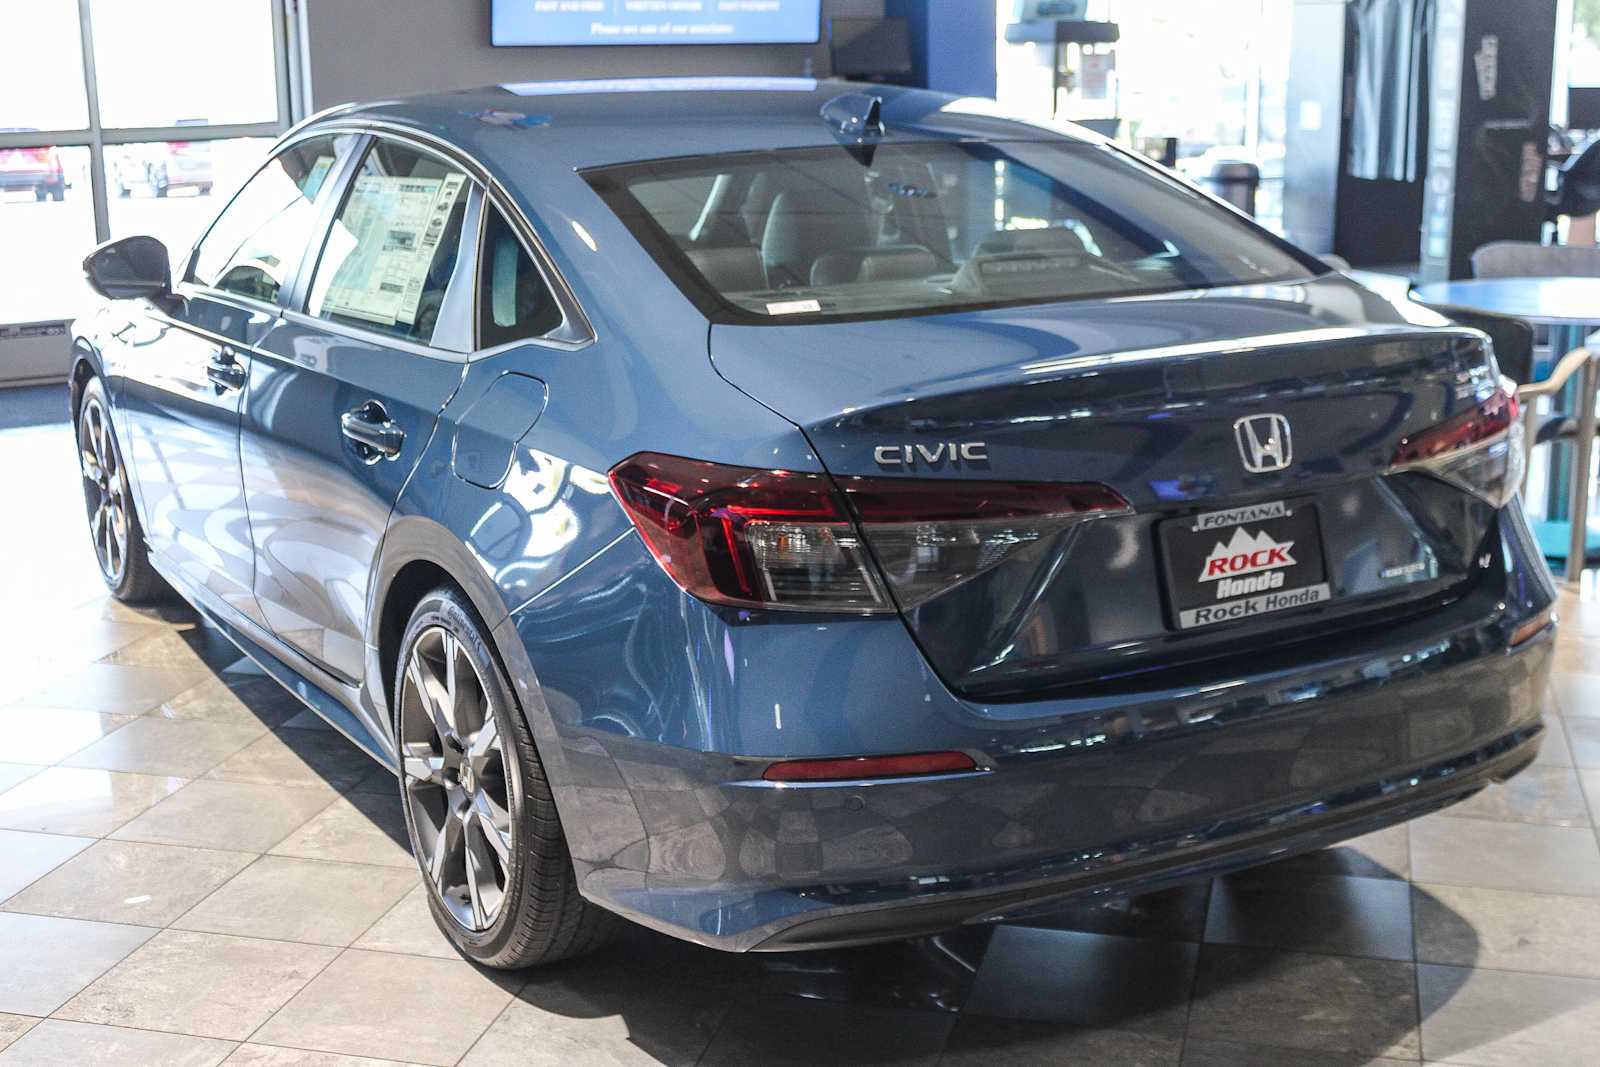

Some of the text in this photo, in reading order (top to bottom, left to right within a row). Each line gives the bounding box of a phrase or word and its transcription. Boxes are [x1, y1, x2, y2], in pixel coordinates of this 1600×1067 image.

[874, 442, 988, 464] CIVIC
[1203, 504, 1283, 528] FONTANA
[1207, 546, 1289, 577] ROCK
[1216, 571, 1285, 599] Honda
[1194, 589, 1320, 625] Rock Honda
